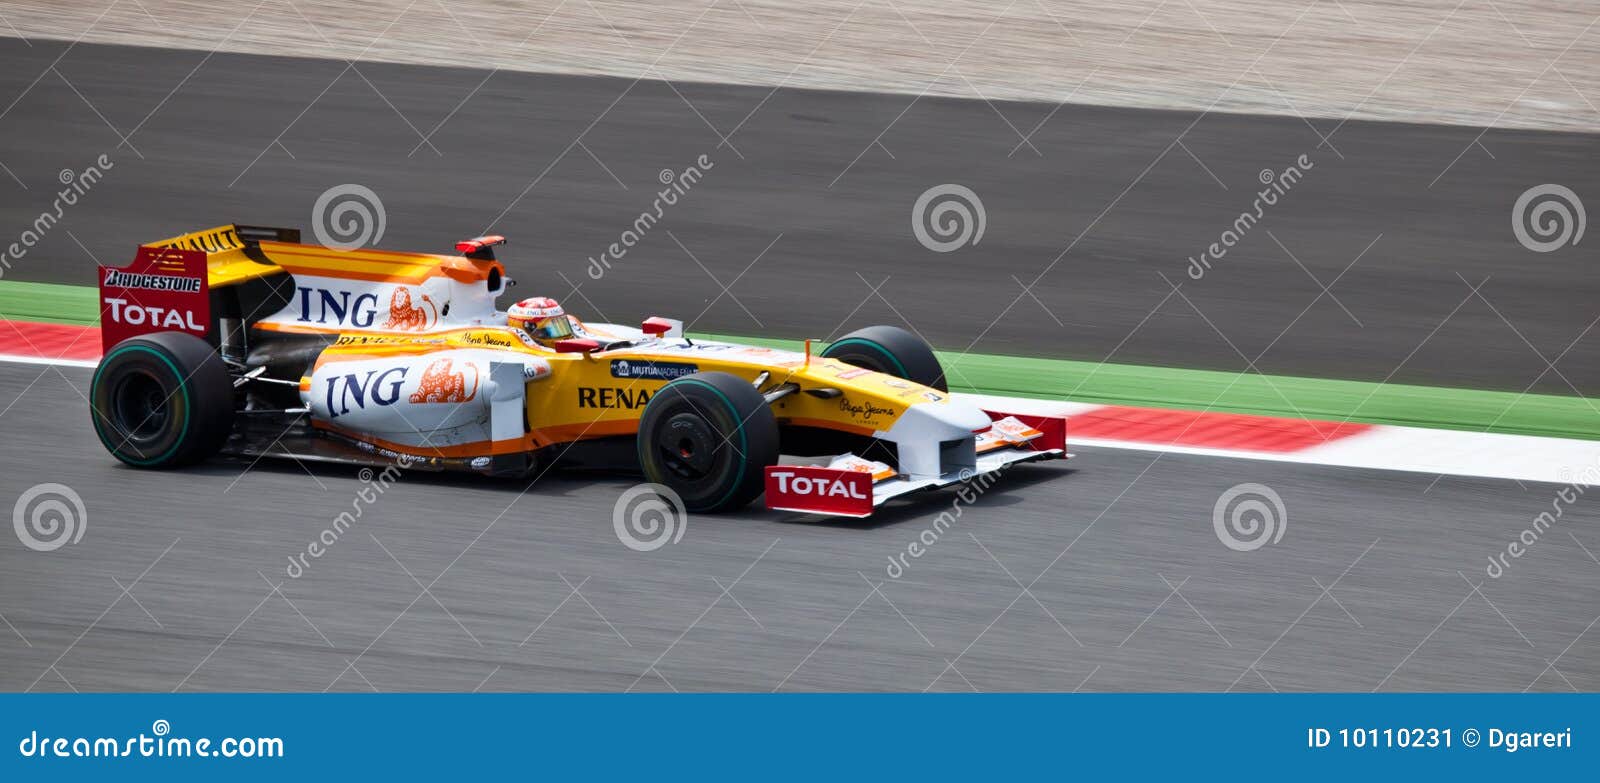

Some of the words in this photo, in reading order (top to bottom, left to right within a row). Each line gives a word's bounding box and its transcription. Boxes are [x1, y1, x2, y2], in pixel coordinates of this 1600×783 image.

[104, 269, 201, 293] BRIDGESTONE
[104, 297, 204, 331] TOTAL
[297, 286, 378, 328] ING
[326, 366, 410, 418] ING
[578, 387, 656, 409] RENA
[839, 398, 864, 417] Pepe
[770, 471, 867, 500] TOTAL
